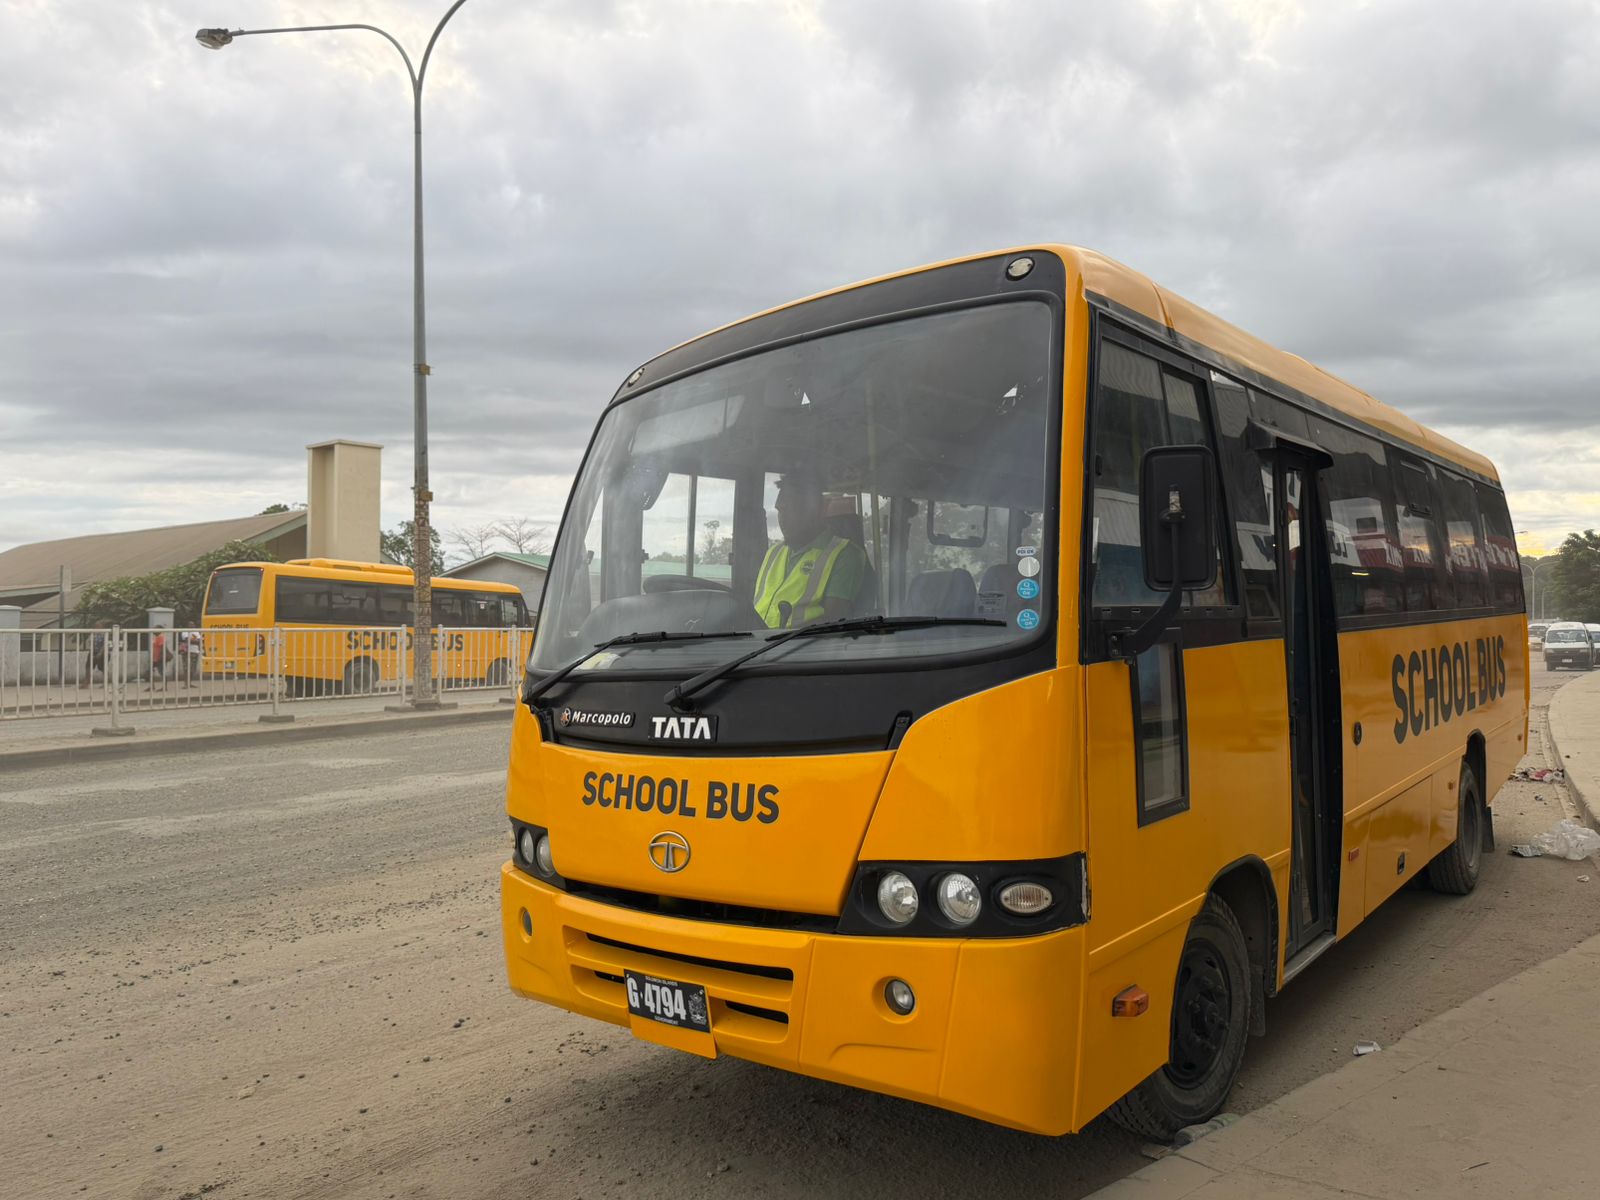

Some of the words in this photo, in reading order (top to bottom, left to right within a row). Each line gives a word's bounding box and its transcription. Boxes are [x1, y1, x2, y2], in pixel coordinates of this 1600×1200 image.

[431, 633, 463, 651] BUS
[1392, 641, 1476, 745] SCHOOL
[1477, 634, 1506, 706] BUS
[571, 710, 632, 726] Marcopolo
[652, 716, 711, 740] TATA
[582, 770, 697, 818] SCHOOL
[706, 780, 780, 825] BUS
[645, 983, 686, 1019] 4794
